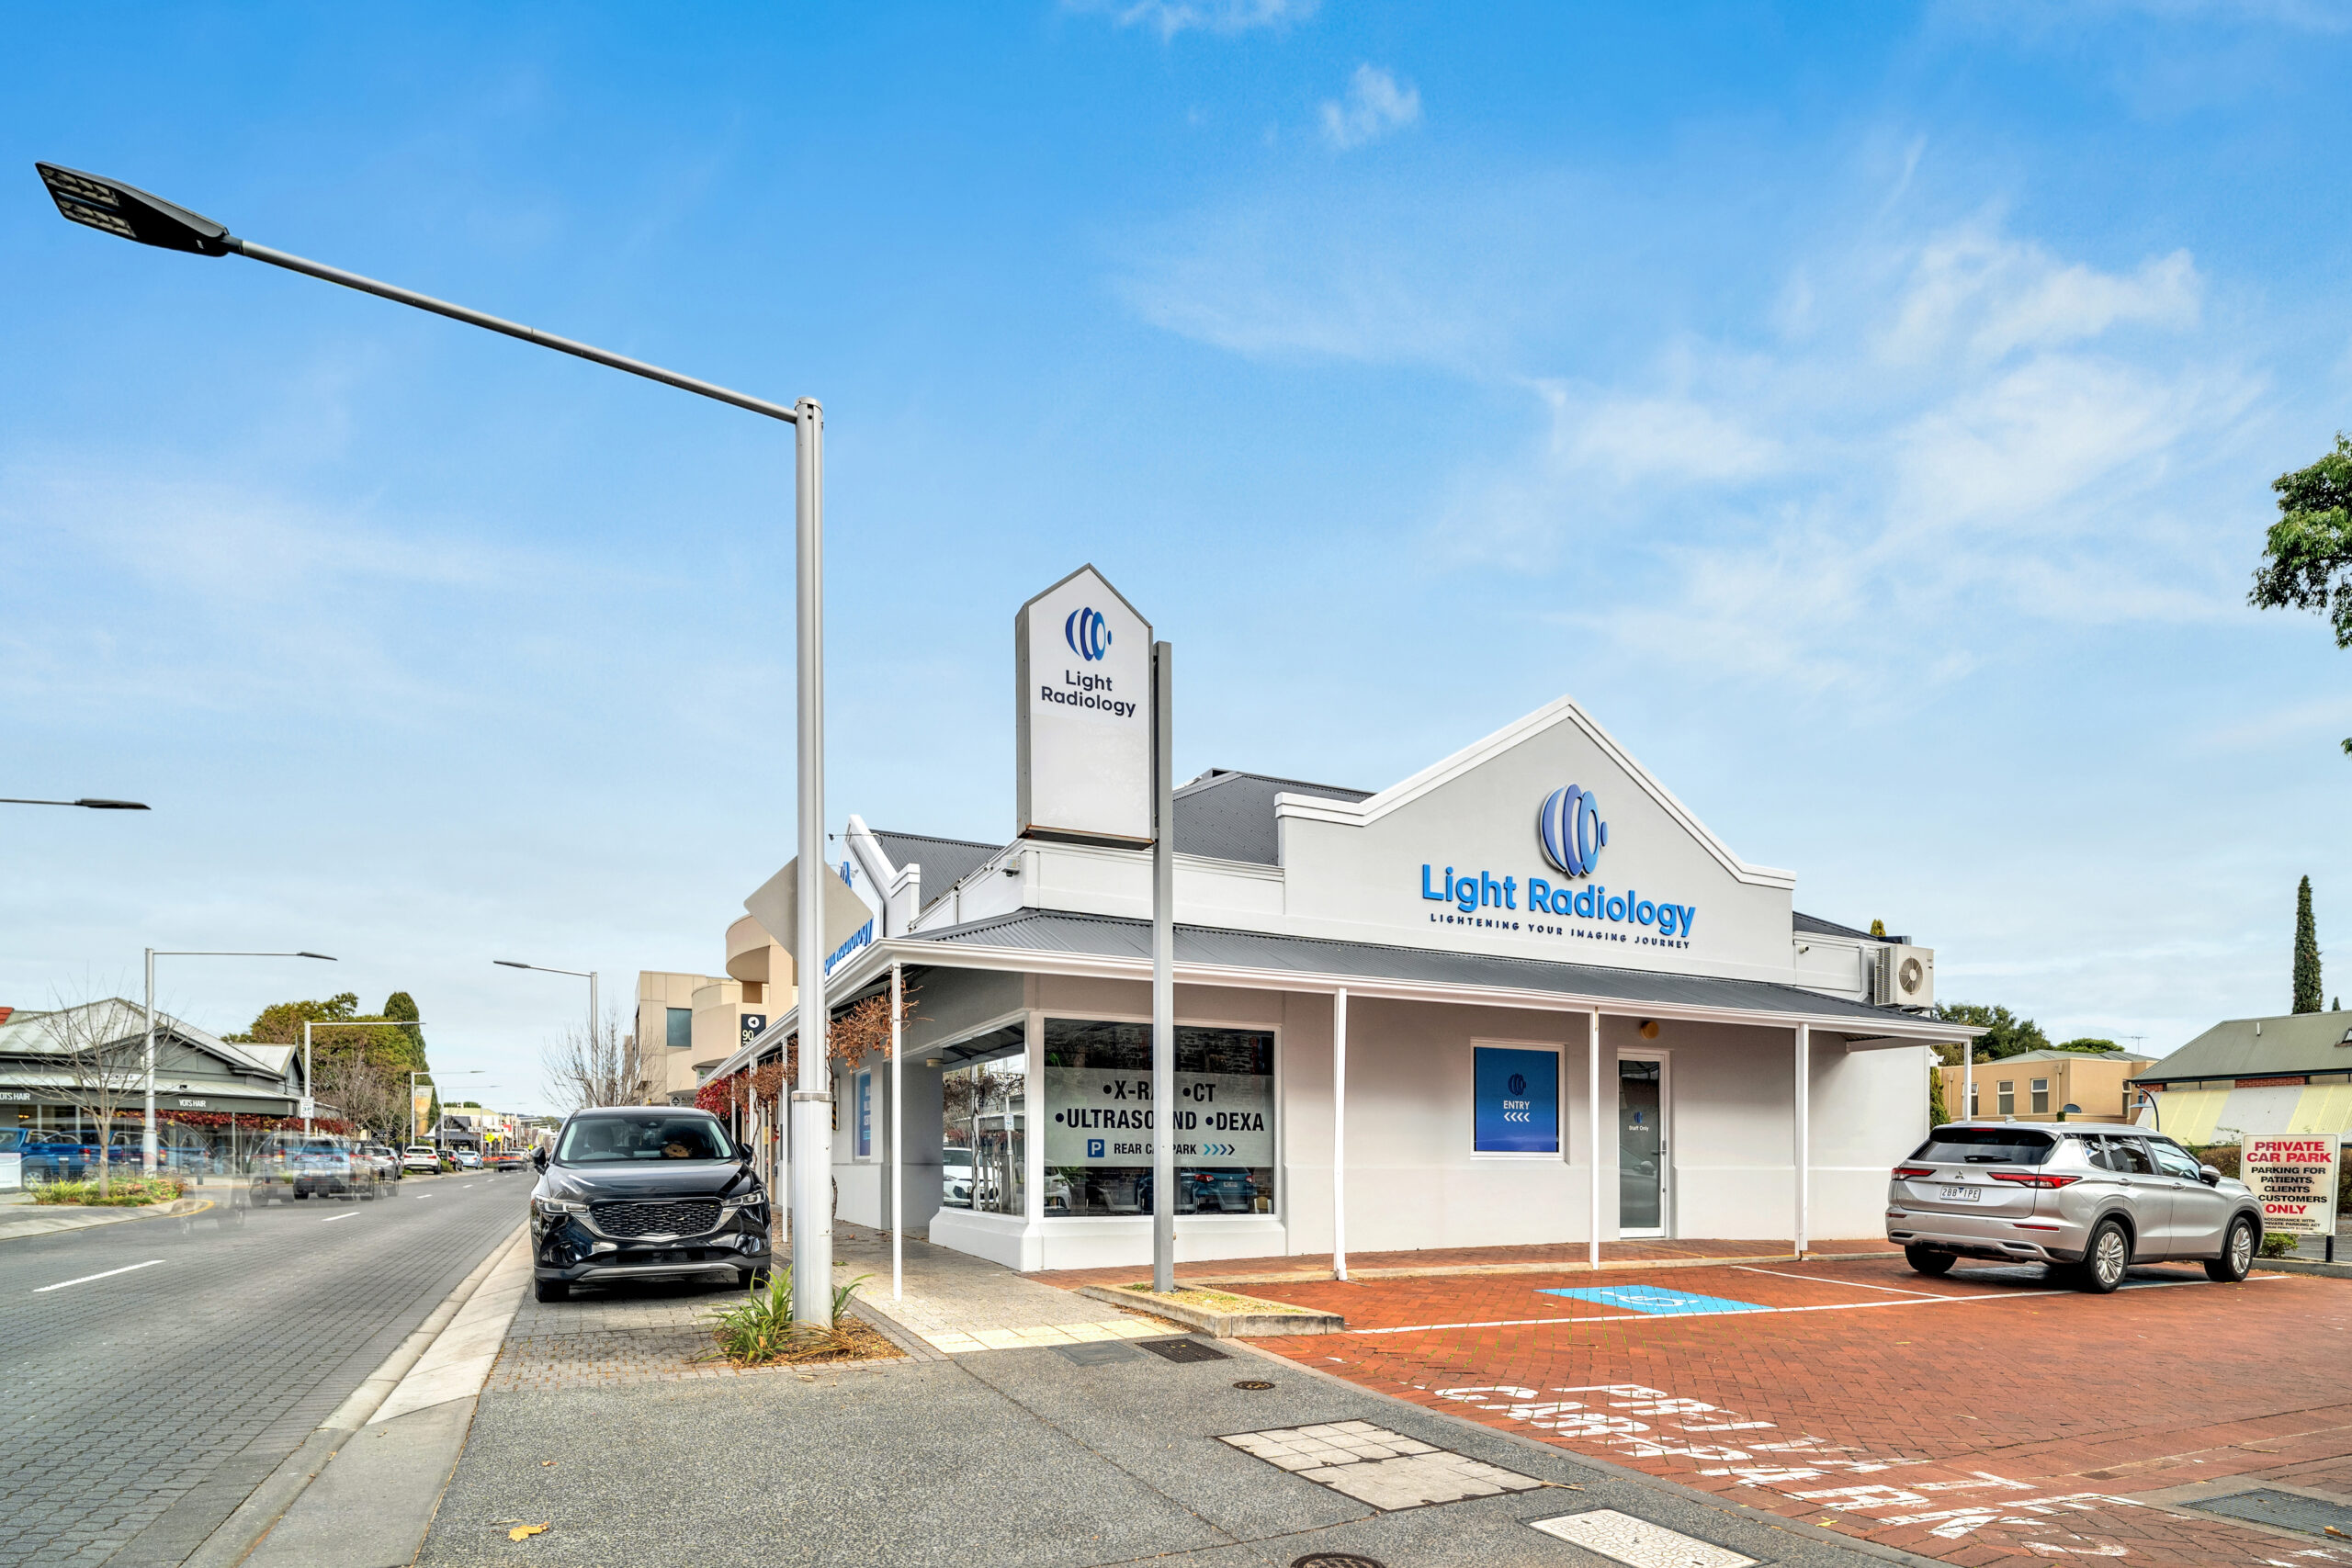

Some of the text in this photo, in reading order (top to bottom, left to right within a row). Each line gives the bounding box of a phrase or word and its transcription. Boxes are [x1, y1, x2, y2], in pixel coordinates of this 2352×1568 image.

[1066, 670, 1113, 692] Light
[1041, 686, 1136, 717] Radiology
[1422, 863, 1696, 937] Light Radiology
[1430, 913, 1690, 949] LIGHTENING YOUR IMAGING JOURNEY
[742, 1030, 754, 1041] 90
[0, 1092, 30, 1100] OTS HAIR
[1114, 1080, 1216, 1102] X-R CT
[1503, 1100, 1531, 1110] ENTRY
[1067, 1108, 1264, 1132] ULTRASOND DEXA
[1114, 1144, 1142, 1155] REAR
[2255, 1142, 2324, 1151] PRIVATE
[2246, 1153, 2332, 1163] CAR PARK
[2264, 1185, 2311, 1193] CLIENTS
[2258, 1194, 2327, 1203] CUSTOMERS
[2266, 1204, 2307, 1214] ONLY
